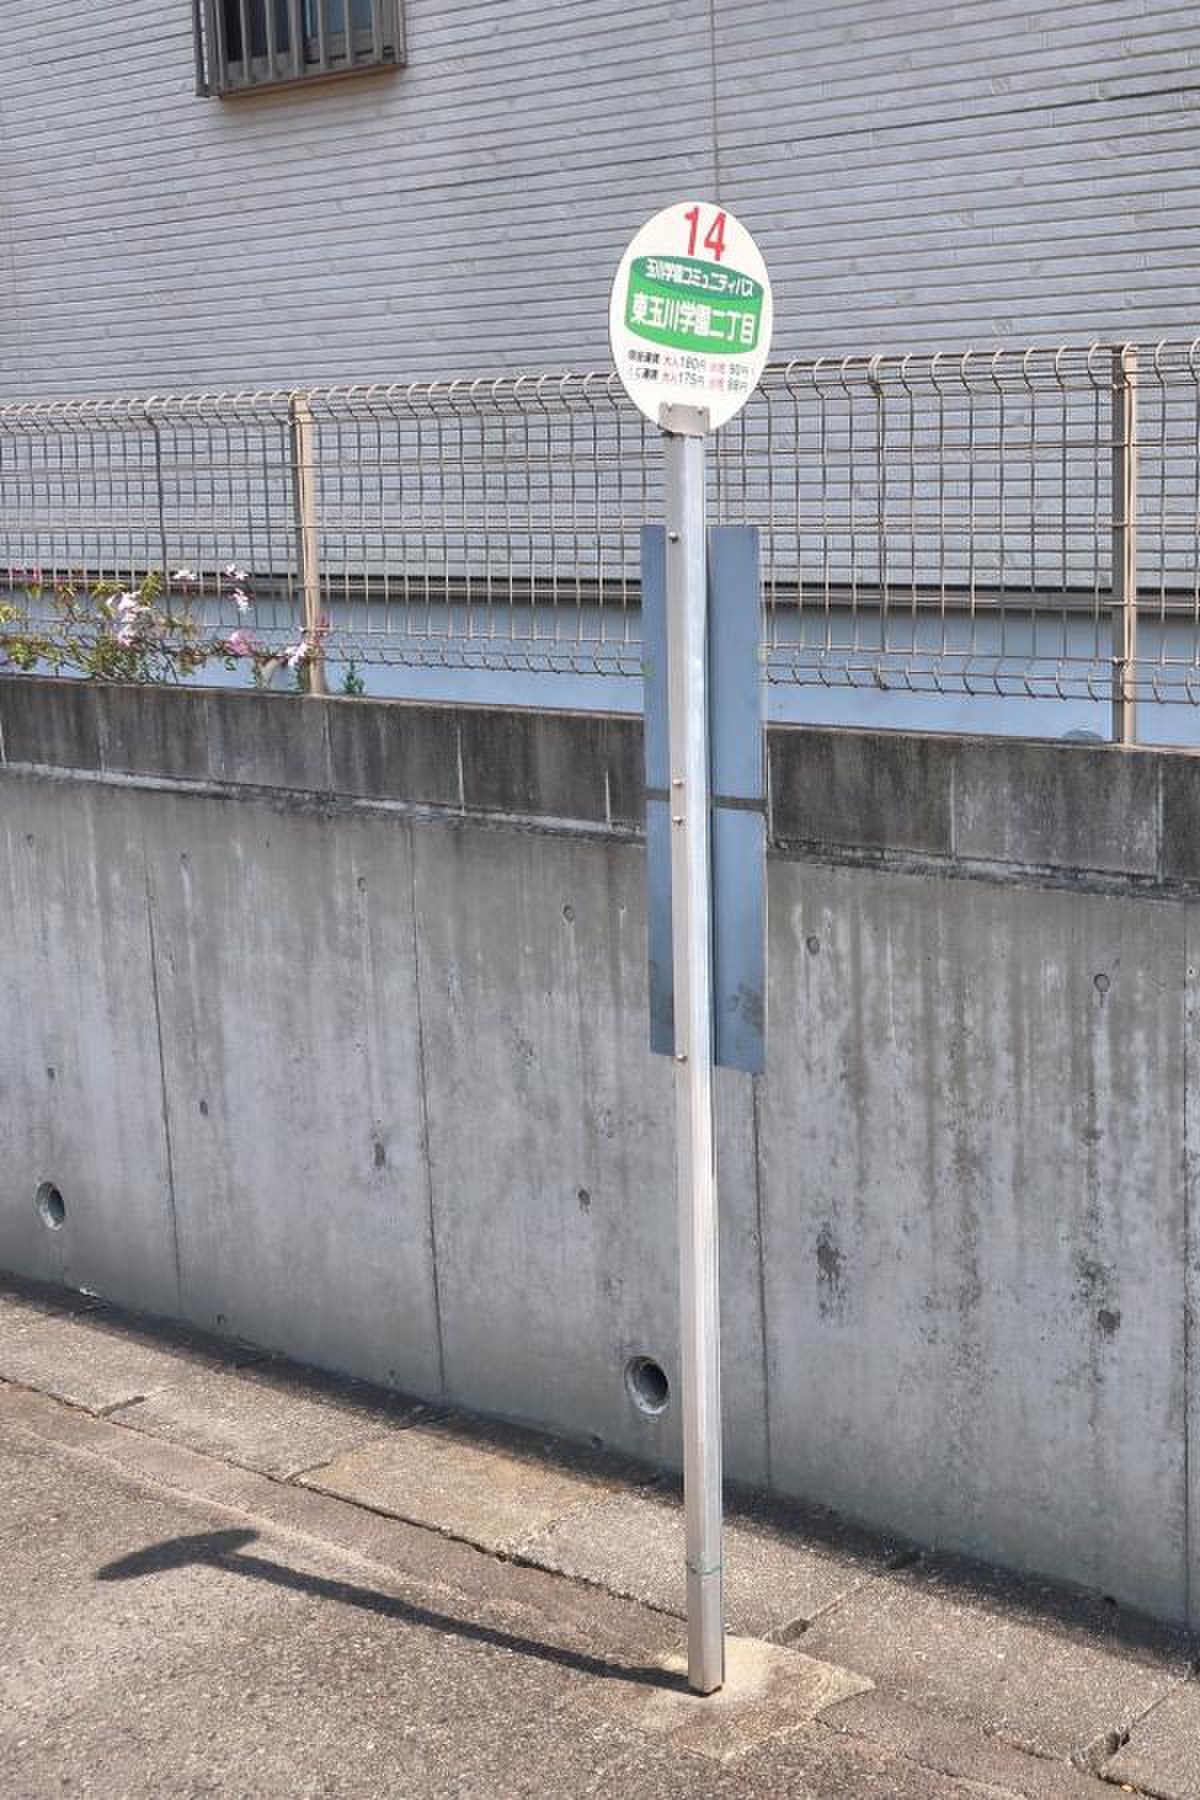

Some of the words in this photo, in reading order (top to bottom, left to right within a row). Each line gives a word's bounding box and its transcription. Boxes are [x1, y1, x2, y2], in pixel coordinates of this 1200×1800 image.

[684, 206, 727, 261] 14
[630, 291, 755, 344] 東玉川学園二丁目
